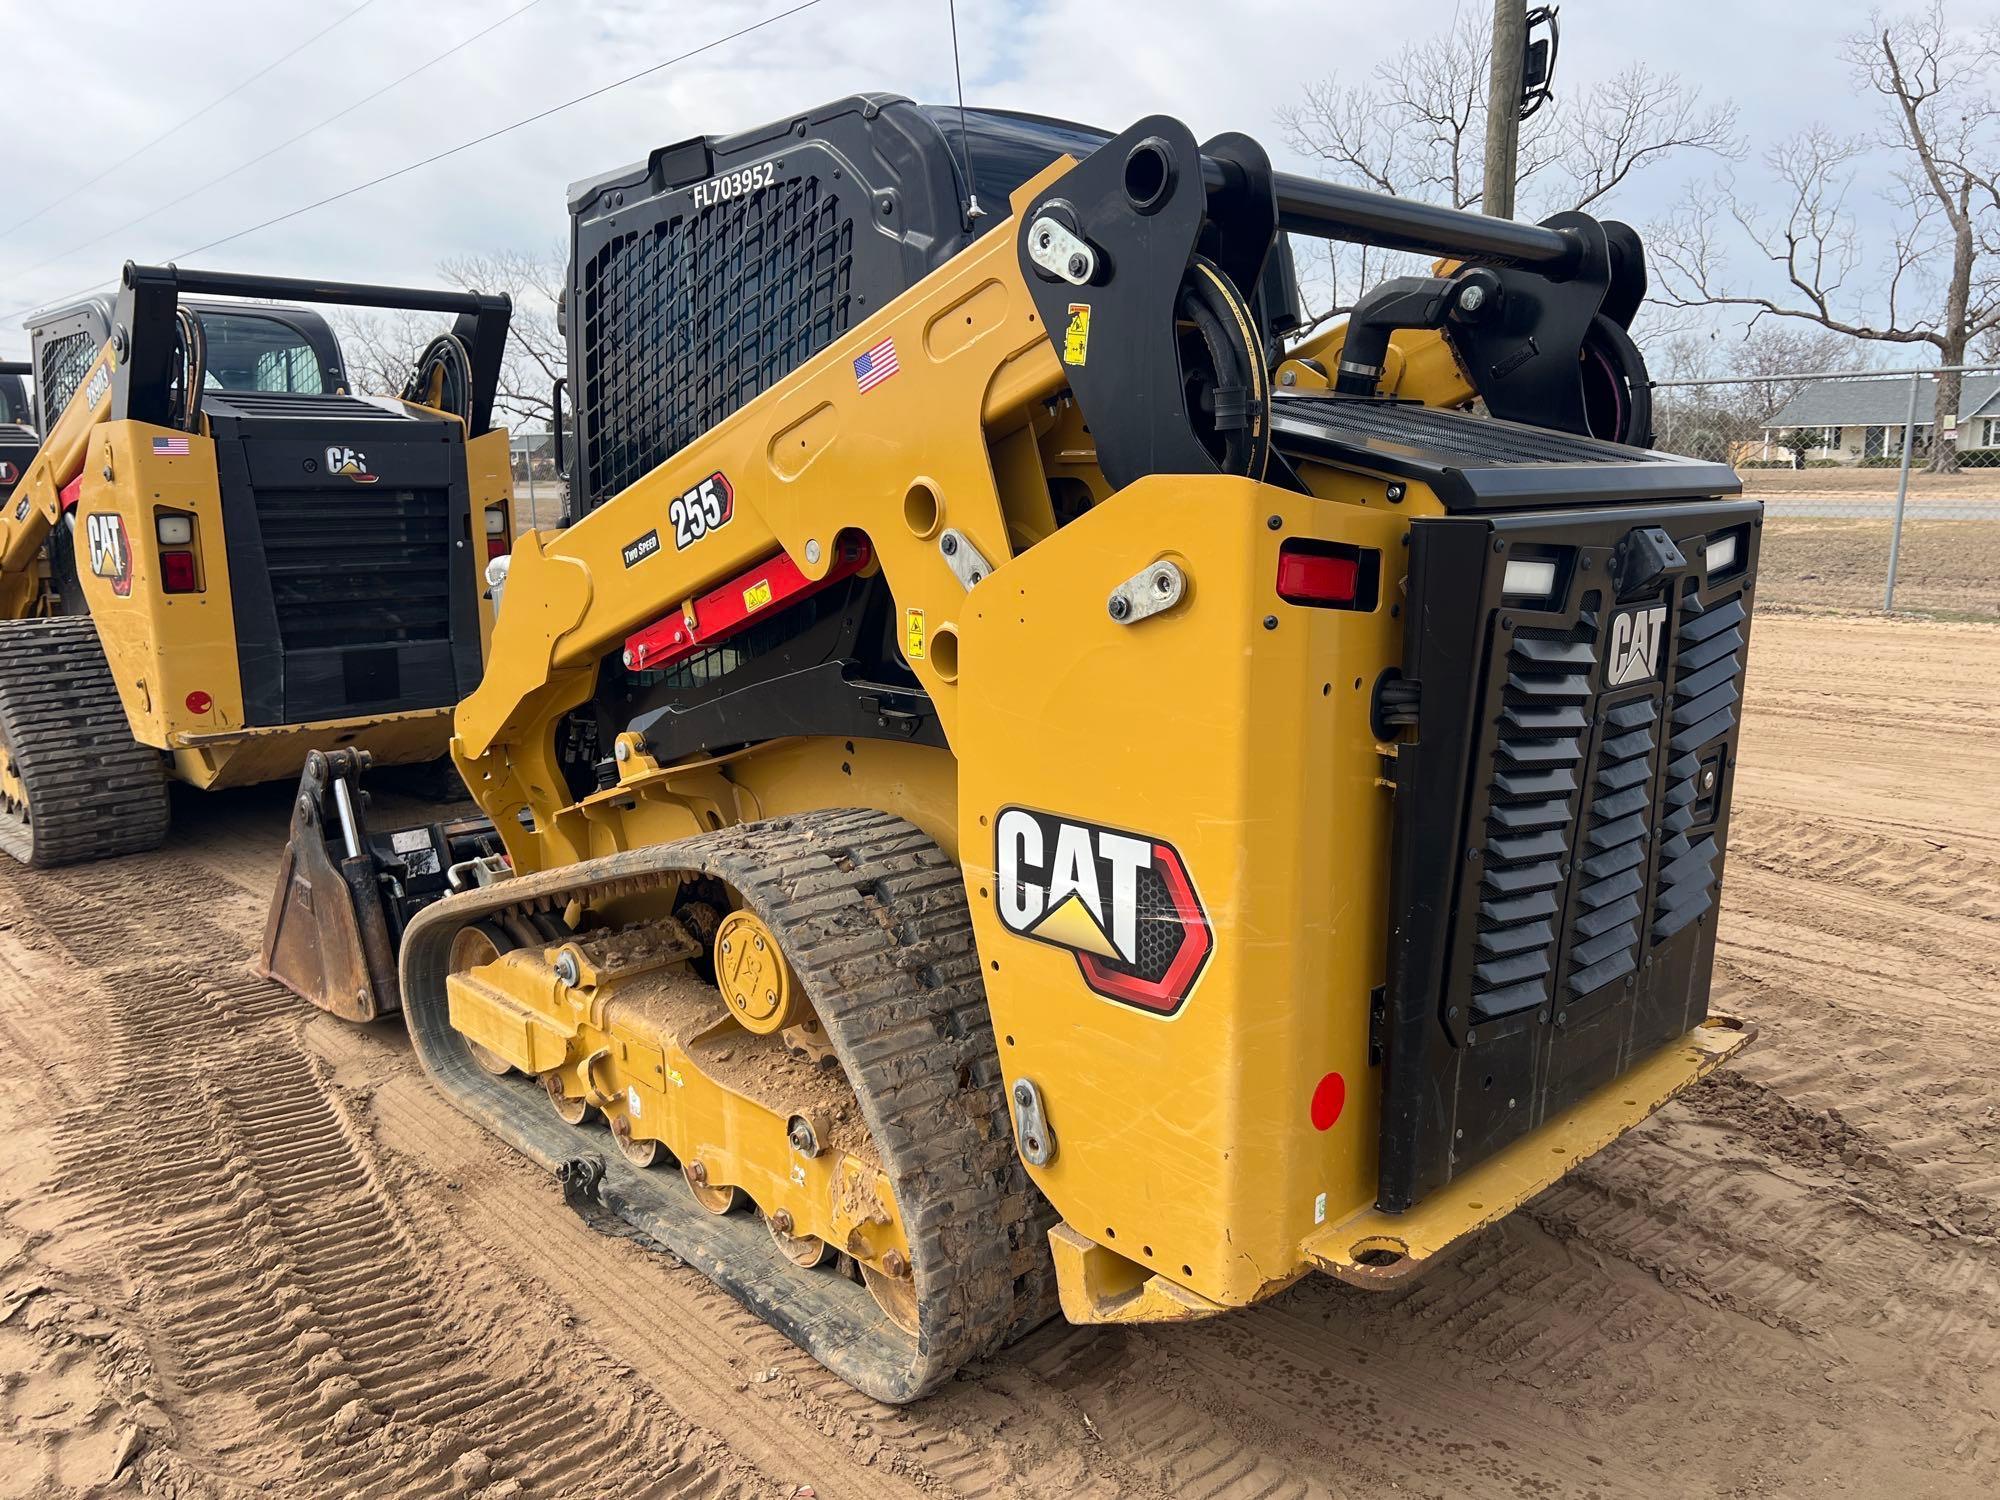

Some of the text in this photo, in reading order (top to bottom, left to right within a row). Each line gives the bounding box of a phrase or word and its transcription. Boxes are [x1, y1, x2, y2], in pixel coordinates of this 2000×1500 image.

[693, 161, 775, 209] FL703952
[88, 515, 122, 575] CAT
[670, 479, 721, 548] 255
[1608, 607, 1667, 686] CAT
[998, 810, 1151, 965] CAT
